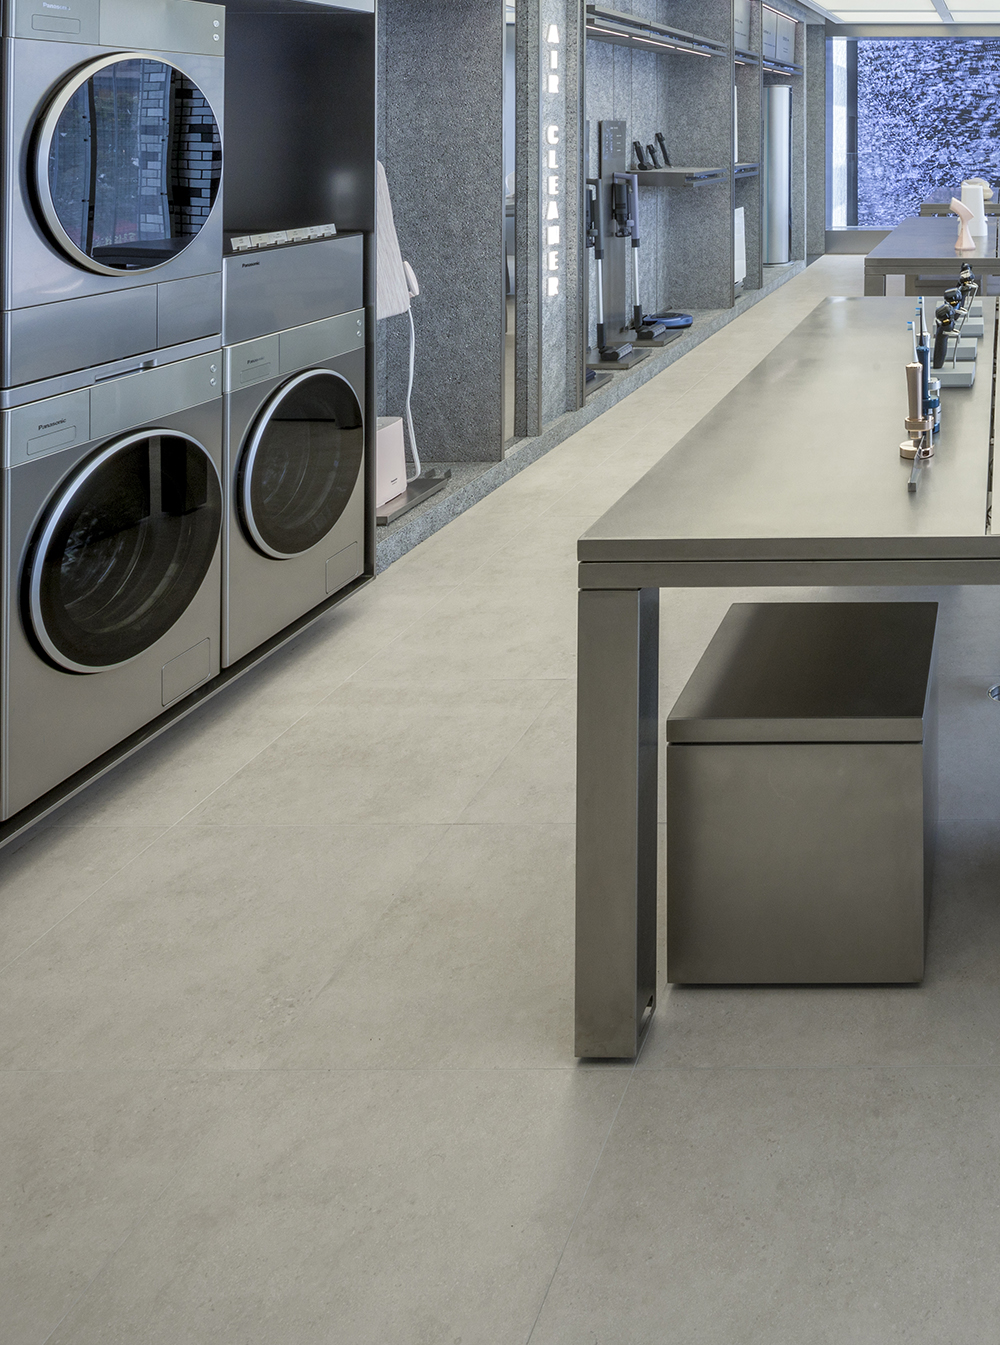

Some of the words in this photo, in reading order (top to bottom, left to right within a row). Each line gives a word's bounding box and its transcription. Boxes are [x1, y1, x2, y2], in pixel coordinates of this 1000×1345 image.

[547, 24, 560, 94] AIR
[546, 124, 560, 297] CLEANER
[38, 418, 67, 430] Panasonic
